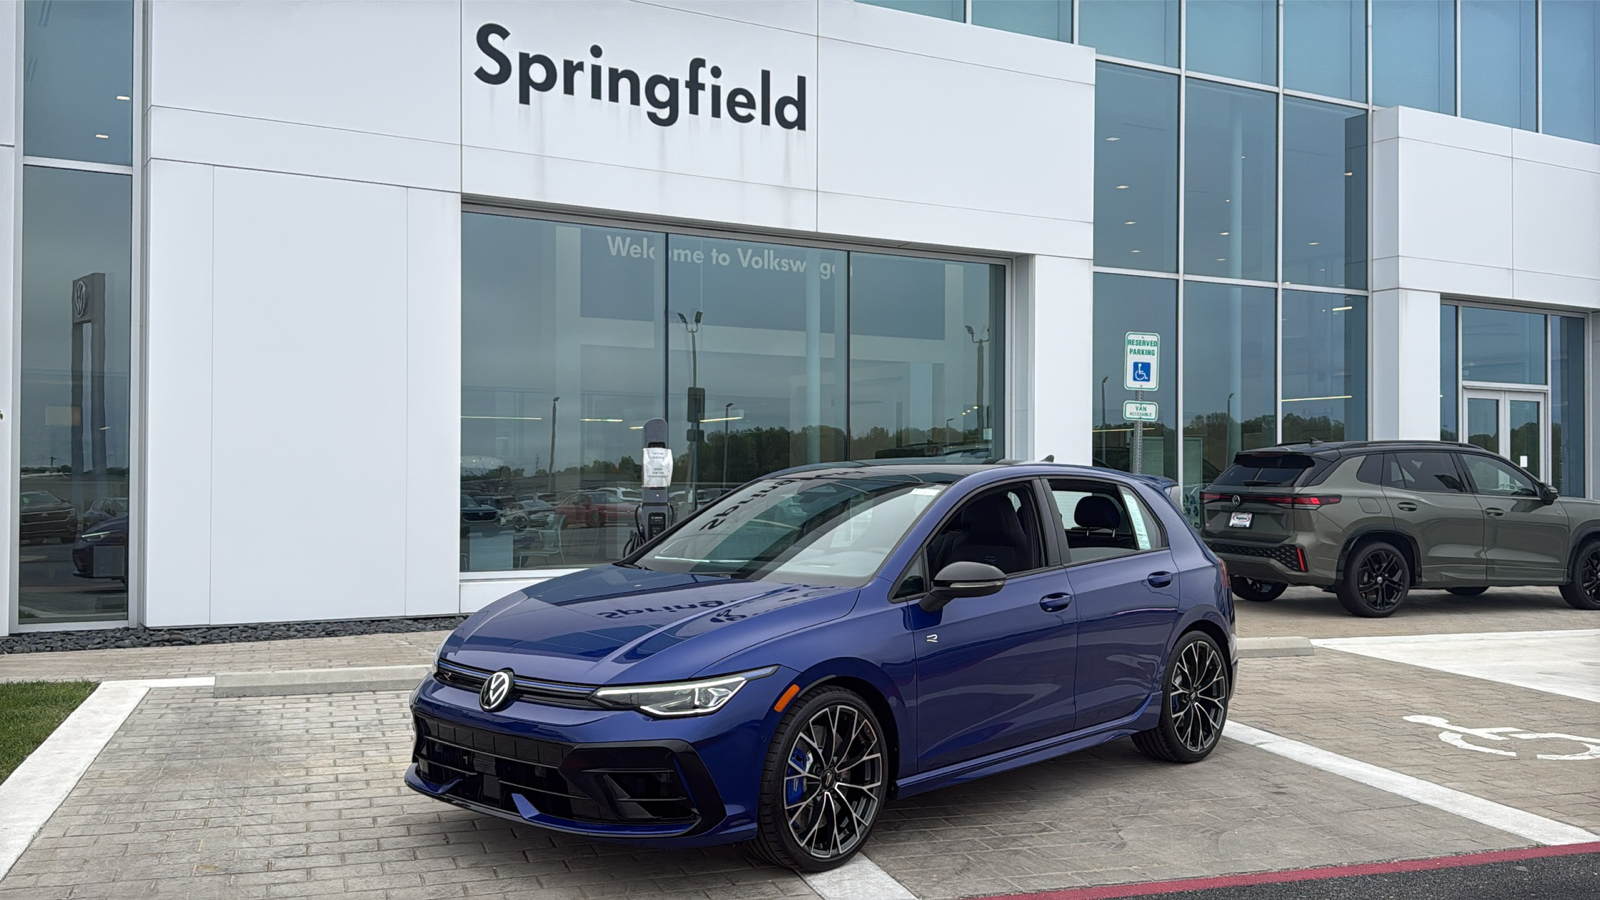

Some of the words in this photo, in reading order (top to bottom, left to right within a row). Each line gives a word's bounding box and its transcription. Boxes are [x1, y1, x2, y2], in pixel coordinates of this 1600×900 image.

[474, 23, 807, 131] Springfield
[606, 235, 704, 264] Welcme
[711, 248, 730, 266] to
[736, 247, 853, 280] Volkswg
[1127, 339, 1158, 347] RESERVED
[1129, 348, 1155, 356] PARKING
